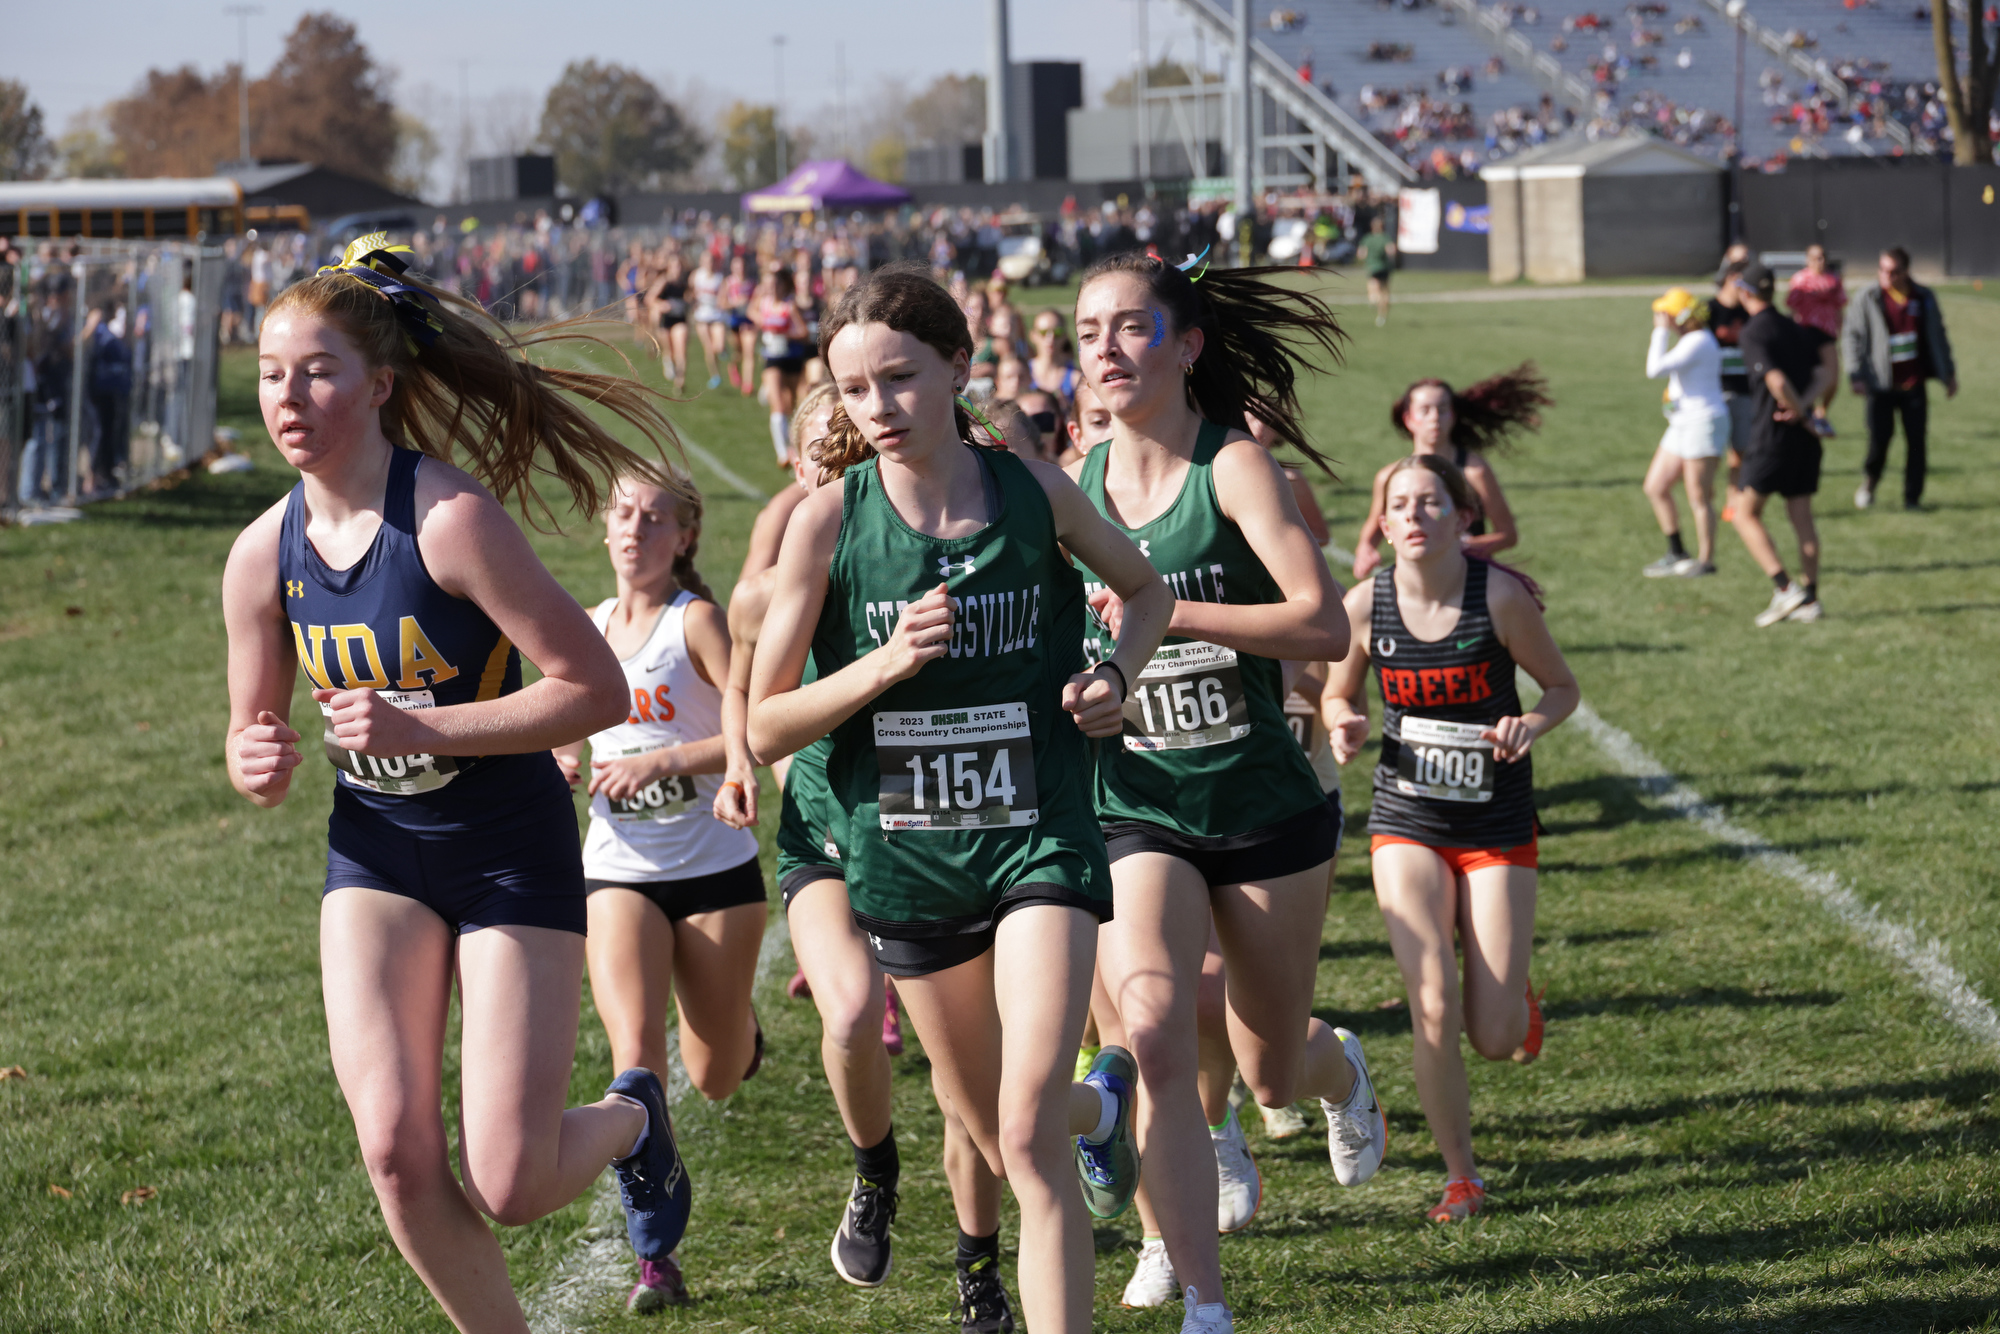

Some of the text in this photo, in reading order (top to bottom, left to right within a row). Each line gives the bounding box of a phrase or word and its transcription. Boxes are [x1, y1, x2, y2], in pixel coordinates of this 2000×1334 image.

[866, 584, 1040, 658] STGSVILLE
[290, 615, 459, 690] NDA
[1144, 654, 1235, 670] untry Championships
[1185, 646, 1214, 656] STATE
[1134, 677, 1229, 733] 1156
[1381, 661, 1492, 707] CREEK
[877, 720, 1027, 737] Cross Country Championships
[899, 711, 1006, 726] 2023 OHSAA STATE
[905, 748, 1017, 810] 1154
[1414, 746, 1485, 788] 1009
[893, 820, 924, 828] MileSplit
